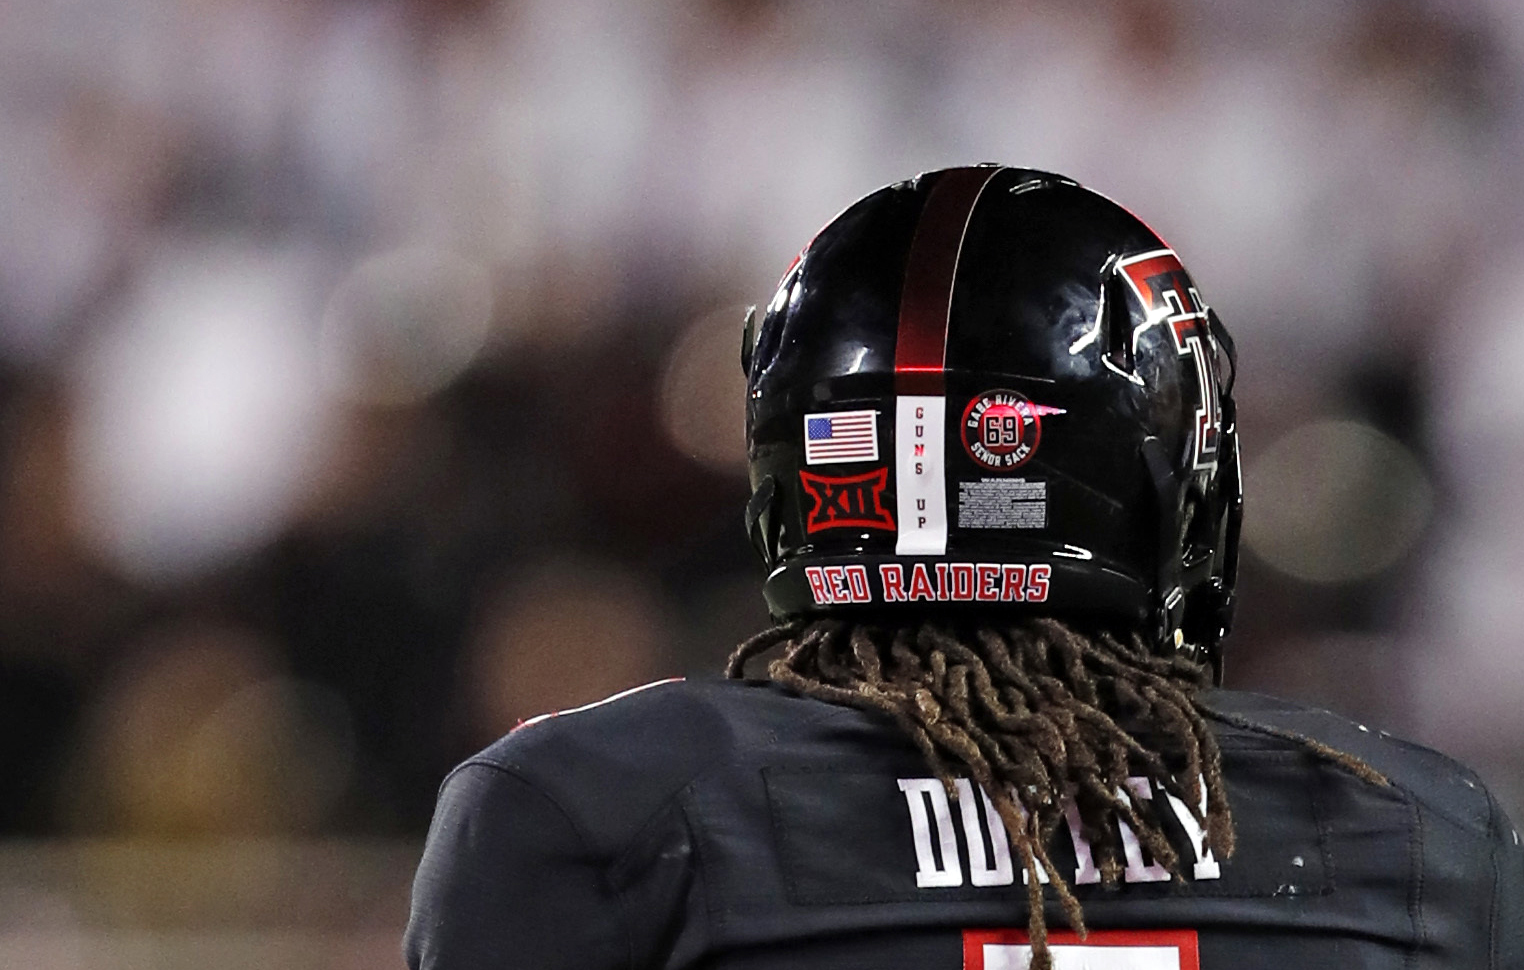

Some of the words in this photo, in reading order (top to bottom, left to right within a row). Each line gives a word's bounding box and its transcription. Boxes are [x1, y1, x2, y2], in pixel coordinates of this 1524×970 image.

[967, 397, 993, 428] GABE
[995, 394, 1034, 426] RIVERA
[914, 406, 925, 475] GUNS
[984, 414, 1019, 446] 69
[1005, 442, 1031, 466] SACK
[916, 498, 926, 528] UP
[805, 564, 872, 604] RED
[879, 563, 1052, 603] RAIDERS
